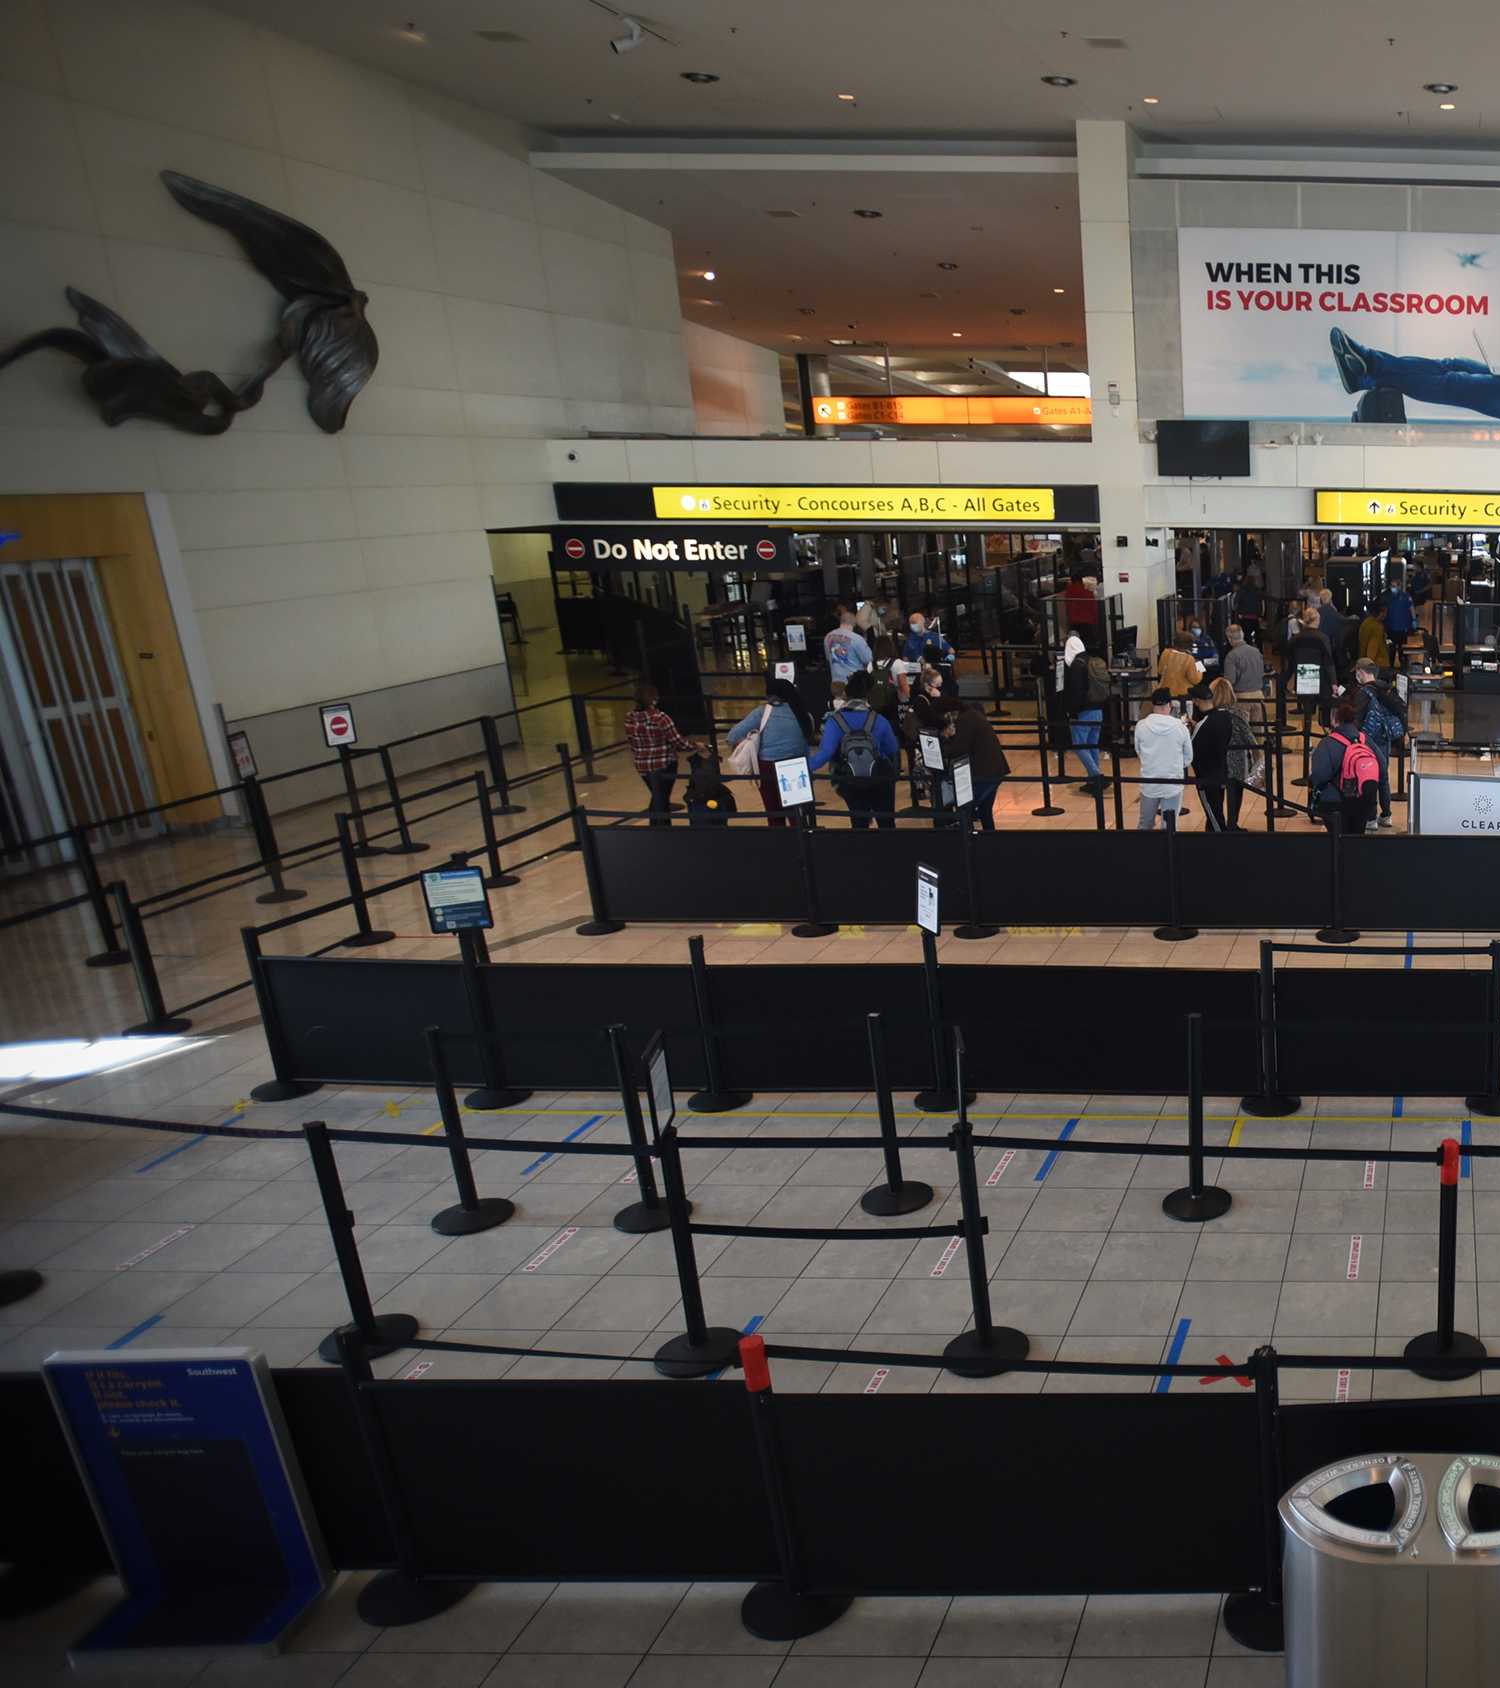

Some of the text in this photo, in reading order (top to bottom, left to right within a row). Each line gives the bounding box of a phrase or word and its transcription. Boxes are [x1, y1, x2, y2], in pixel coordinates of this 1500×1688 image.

[1205, 262, 1361, 285] WHEN THIS
[1207, 290, 1489, 315] IS YOUR CLASSROOM
[1042, 406, 1091, 416] Gates A1-A
[713, 494, 779, 514] Security
[798, 496, 894, 512] Concourses
[901, 497, 945, 515] A,B,C
[964, 497, 986, 513] All
[992, 498, 1040, 513] Gates
[1400, 500, 1467, 519] Security
[593, 539, 748, 561] Do Not Enter
[187, 1367, 237, 1377] Southwest
